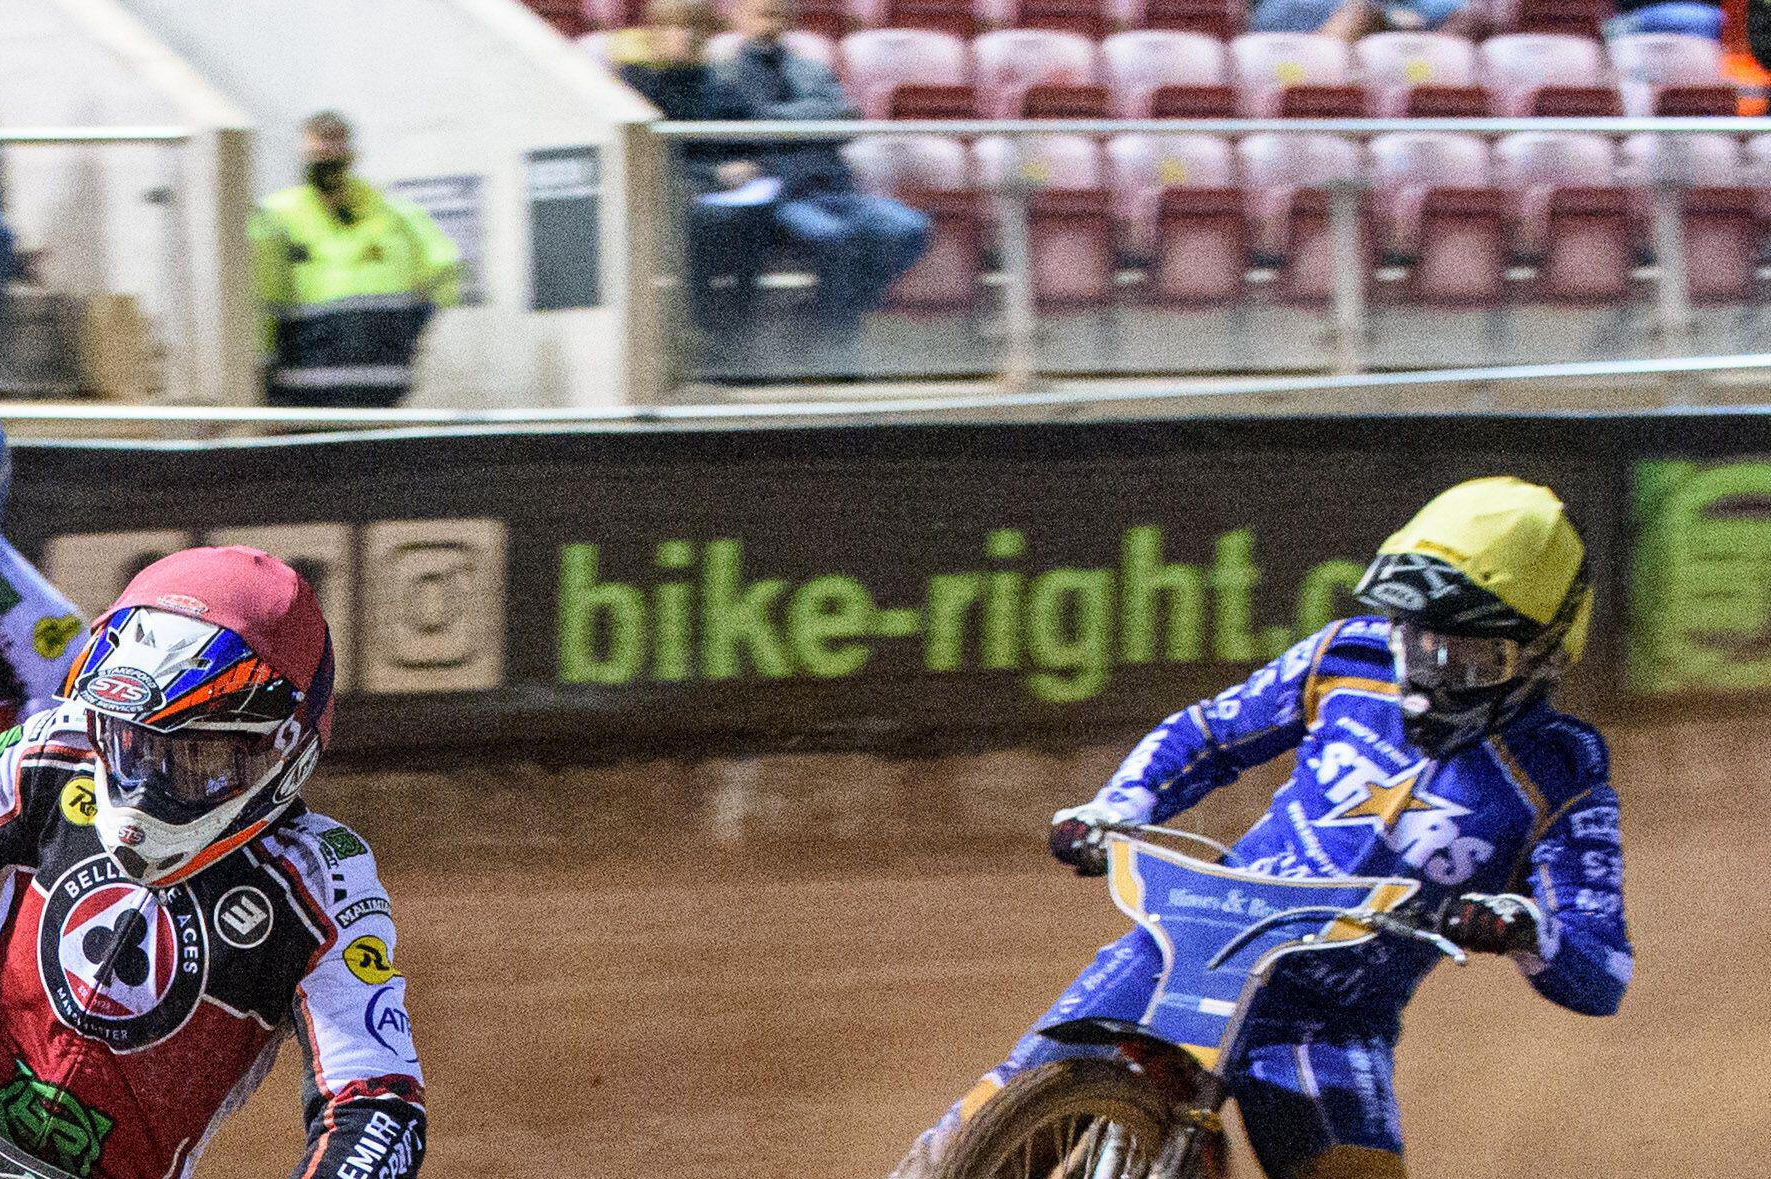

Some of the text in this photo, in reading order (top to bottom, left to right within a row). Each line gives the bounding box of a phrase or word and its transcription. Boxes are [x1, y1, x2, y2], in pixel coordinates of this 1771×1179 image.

[88, 678, 150, 701] STS
[64, 861, 127, 900] BELL
[177, 914, 199, 974] ACES
